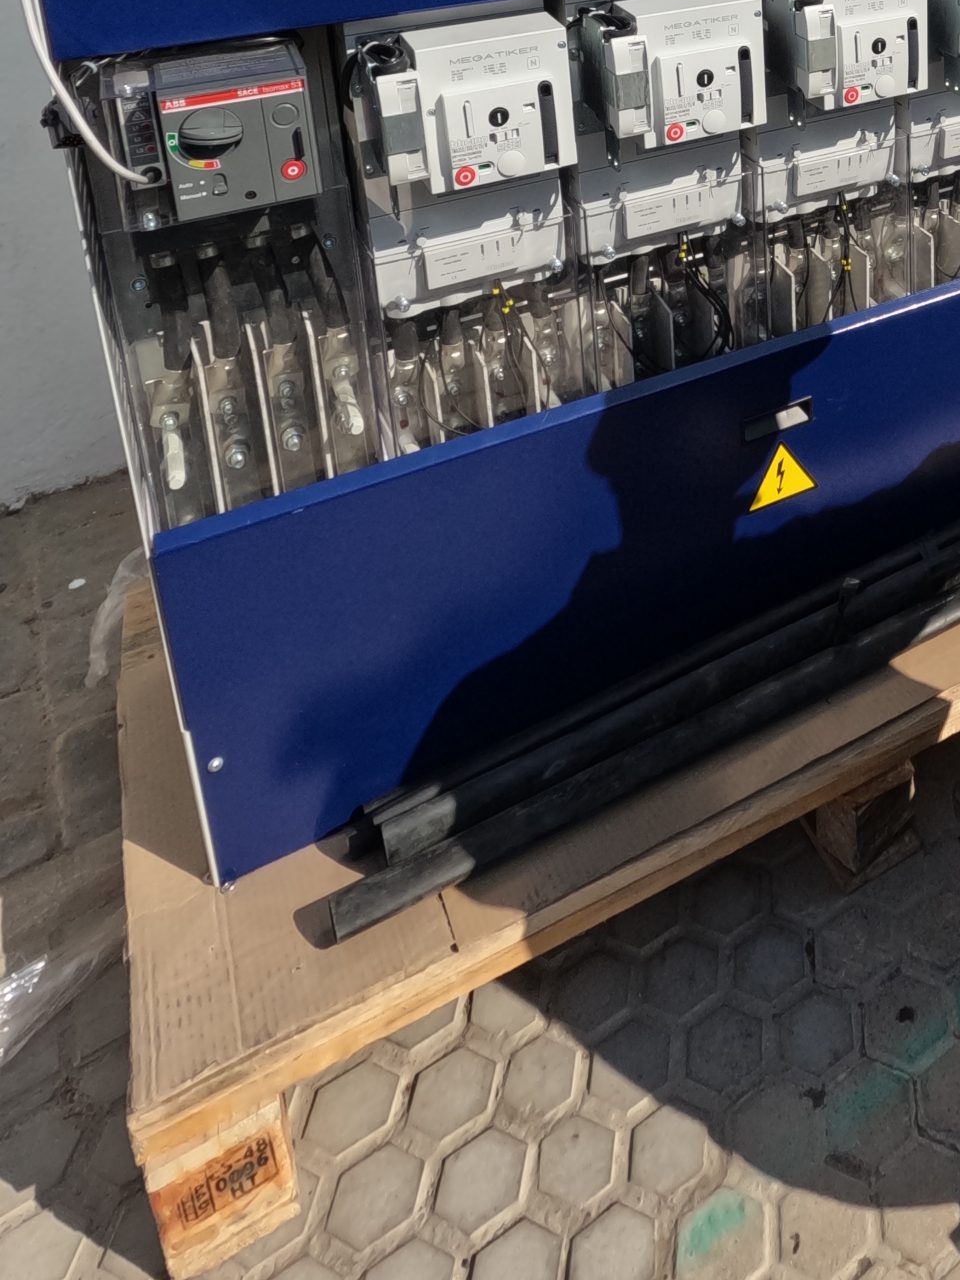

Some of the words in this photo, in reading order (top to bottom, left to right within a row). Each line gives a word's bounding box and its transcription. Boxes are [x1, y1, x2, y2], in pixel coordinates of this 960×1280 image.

[663, 14, 739, 31] MEGATIKER
[449, 45, 539, 66] MEGATIKER
[165, 98, 186, 110] ABB
[237, 87, 259, 97] SACE
